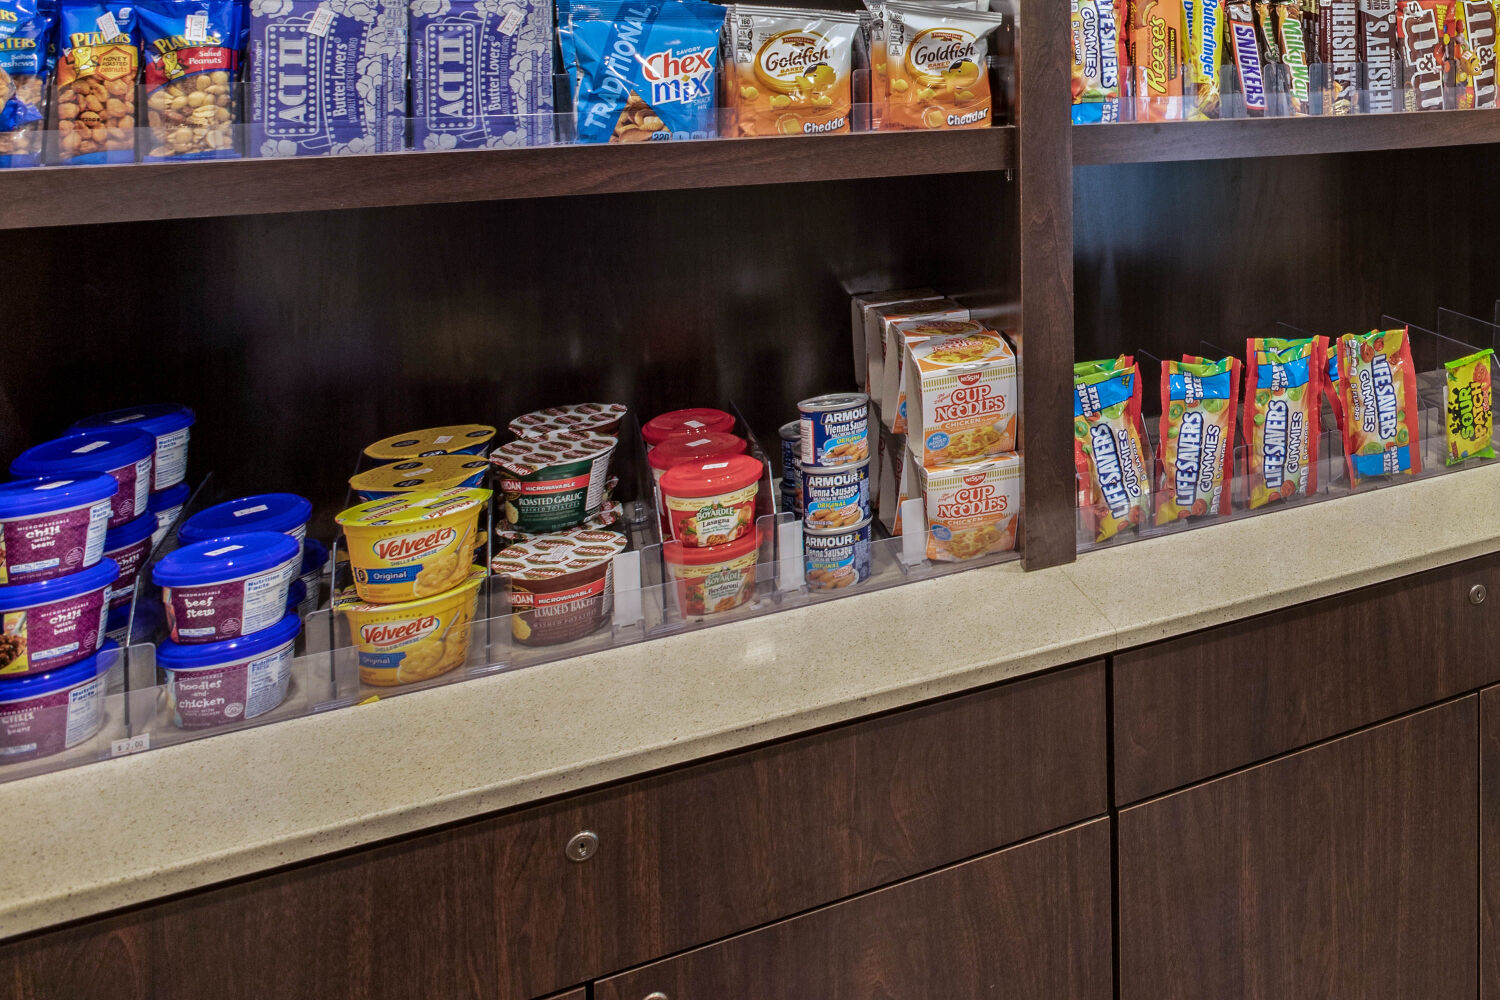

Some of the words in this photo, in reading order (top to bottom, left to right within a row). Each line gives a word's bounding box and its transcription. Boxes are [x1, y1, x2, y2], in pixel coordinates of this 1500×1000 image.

[279, 36, 307, 67] II
[438, 35, 465, 65] II
[675, 46, 701, 56] SAVORY
[1073, 29, 1082, 66] FLAVORS
[1081, 7, 1097, 78] GUMMIES
[1332, 0, 1357, 99] HERSHEY'S
[188, 57, 222, 66] Peanuts
[198, 50, 222, 58] Salted
[331, 44, 347, 80] Lovers
[486, 41, 502, 75] Lovers
[643, 46, 716, 82] Chex
[765, 45, 830, 72] Goldfish
[914, 42, 976, 66] Goldfish
[1146, 15, 1167, 94] Reese's
[584, 6, 653, 129] TRADITIONAL
[1234, 25, 1266, 109] SNICKERS
[1366, 20, 1394, 114] HERSHEY'S
[438, 69, 465, 118] ACT
[487, 76, 502, 111] Butter
[653, 71, 711, 104] mix
[278, 71, 307, 125] ACT
[332, 81, 347, 118] Butter
[946, 106, 989, 127] Cheddar
[960, 374, 980, 382] NISSIN
[1279, 364, 1289, 386] SIZE
[951, 385, 992, 405] CUP
[1193, 376, 1204, 398] SIZE
[1088, 386, 1101, 411] SIZE
[1359, 369, 1376, 433] GUMMIES
[824, 407, 868, 424] ARMOUR
[935, 395, 1006, 424] NOODLES
[1457, 386, 1475, 440] SOUR
[1472, 381, 1489, 442] PATCH
[825, 422, 849, 436] Vienna
[945, 418, 981, 429] CHICKEN
[836, 434, 862, 445] ORIGINAL
[1286, 411, 1303, 473] GUMMIES
[1118, 429, 1142, 498] GUMMIES
[1200, 424, 1220, 492] GUMMIES
[1383, 451, 1391, 472] SIZE
[525, 482, 576, 492] MICROWAVABLE
[808, 472, 858, 488] ARMOUR
[519, 496, 553, 507] ROASTED
[554, 491, 584, 504] GARLIC
[808, 486, 830, 499] Vienna
[831, 484, 858, 497] Sausage
[954, 485, 995, 505] CUP
[696, 507, 735, 521] BOYARDEE
[816, 501, 846, 509] ORIGINAL
[937, 496, 1008, 520] NOODLES
[702, 518, 730, 528] Lasagna
[948, 516, 984, 527] CHICKEN
[25, 526, 61, 540] chili
[805, 534, 854, 548] ARMOUR
[31, 540, 55, 550] beans
[377, 527, 453, 560] Velveeta
[824, 547, 853, 559] Sausage
[247, 574, 280, 587] Nutrition
[373, 570, 407, 581] Original
[247, 582, 270, 592] Facts
[538, 587, 593, 604] MICROWAVABLE
[708, 583, 739, 596] Beefaroni
[185, 597, 214, 608] beef
[49, 609, 82, 625] chili
[186, 607, 216, 619] stew
[53, 624, 77, 636] beans
[363, 615, 436, 645] Velveeta
[179, 680, 223, 691] noodles
[179, 697, 225, 710] chicken
[7, 725, 31, 736] beans
